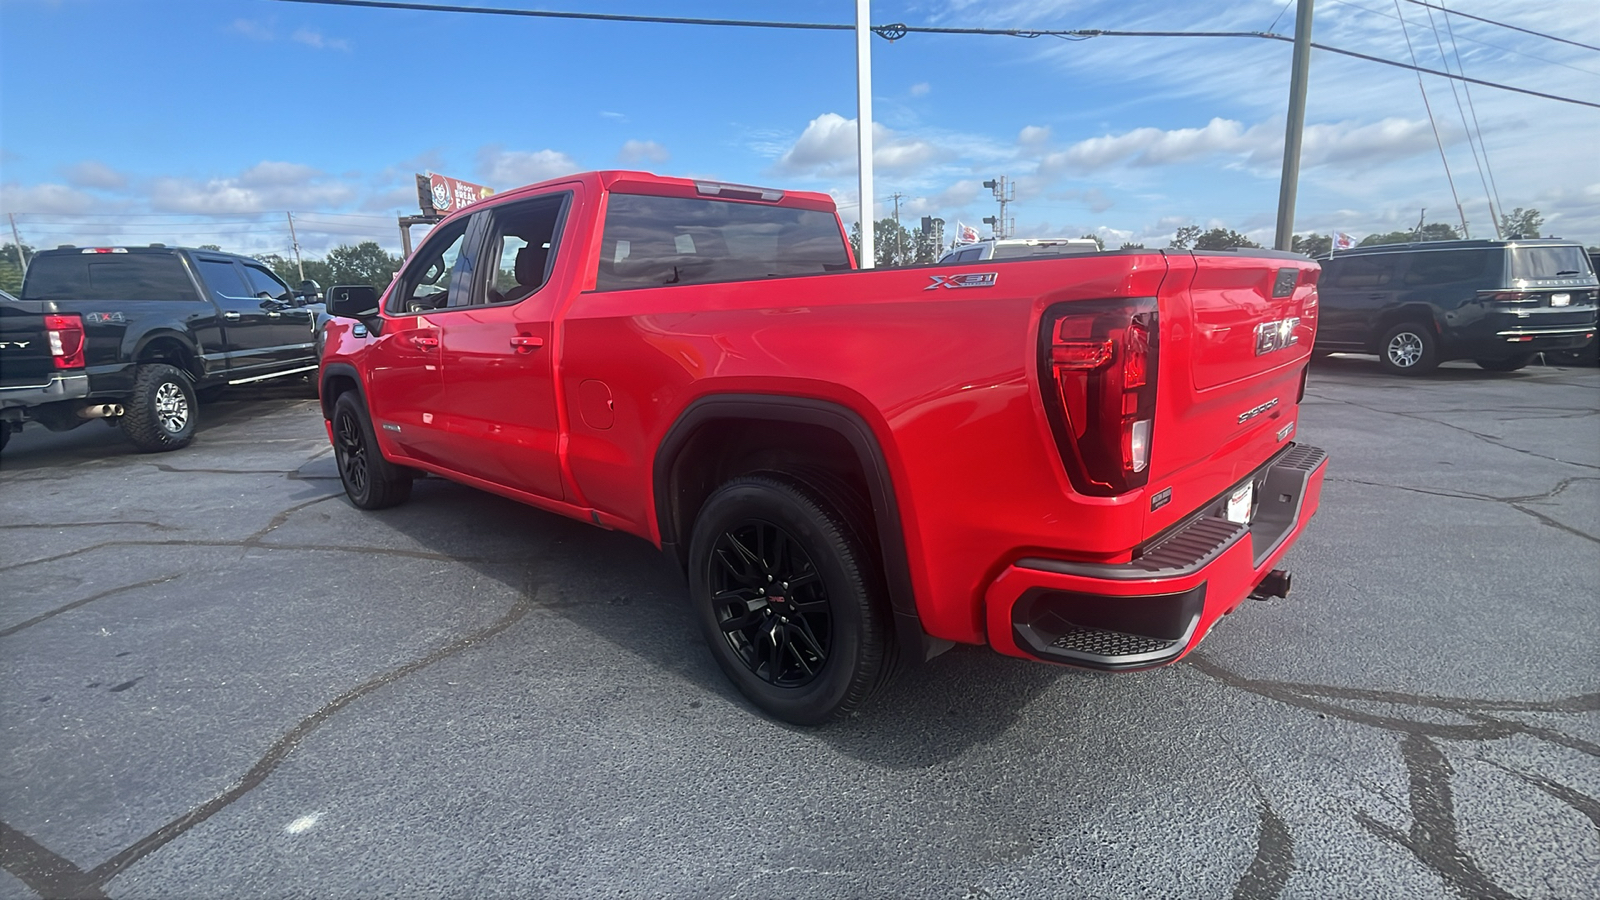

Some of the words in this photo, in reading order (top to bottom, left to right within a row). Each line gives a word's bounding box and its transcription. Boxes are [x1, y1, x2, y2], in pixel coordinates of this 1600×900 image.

[454, 189, 477, 201] BREAK
[455, 198, 475, 209] FA
[1255, 317, 1300, 356] GMC
[1237, 397, 1279, 425] SIERRA
